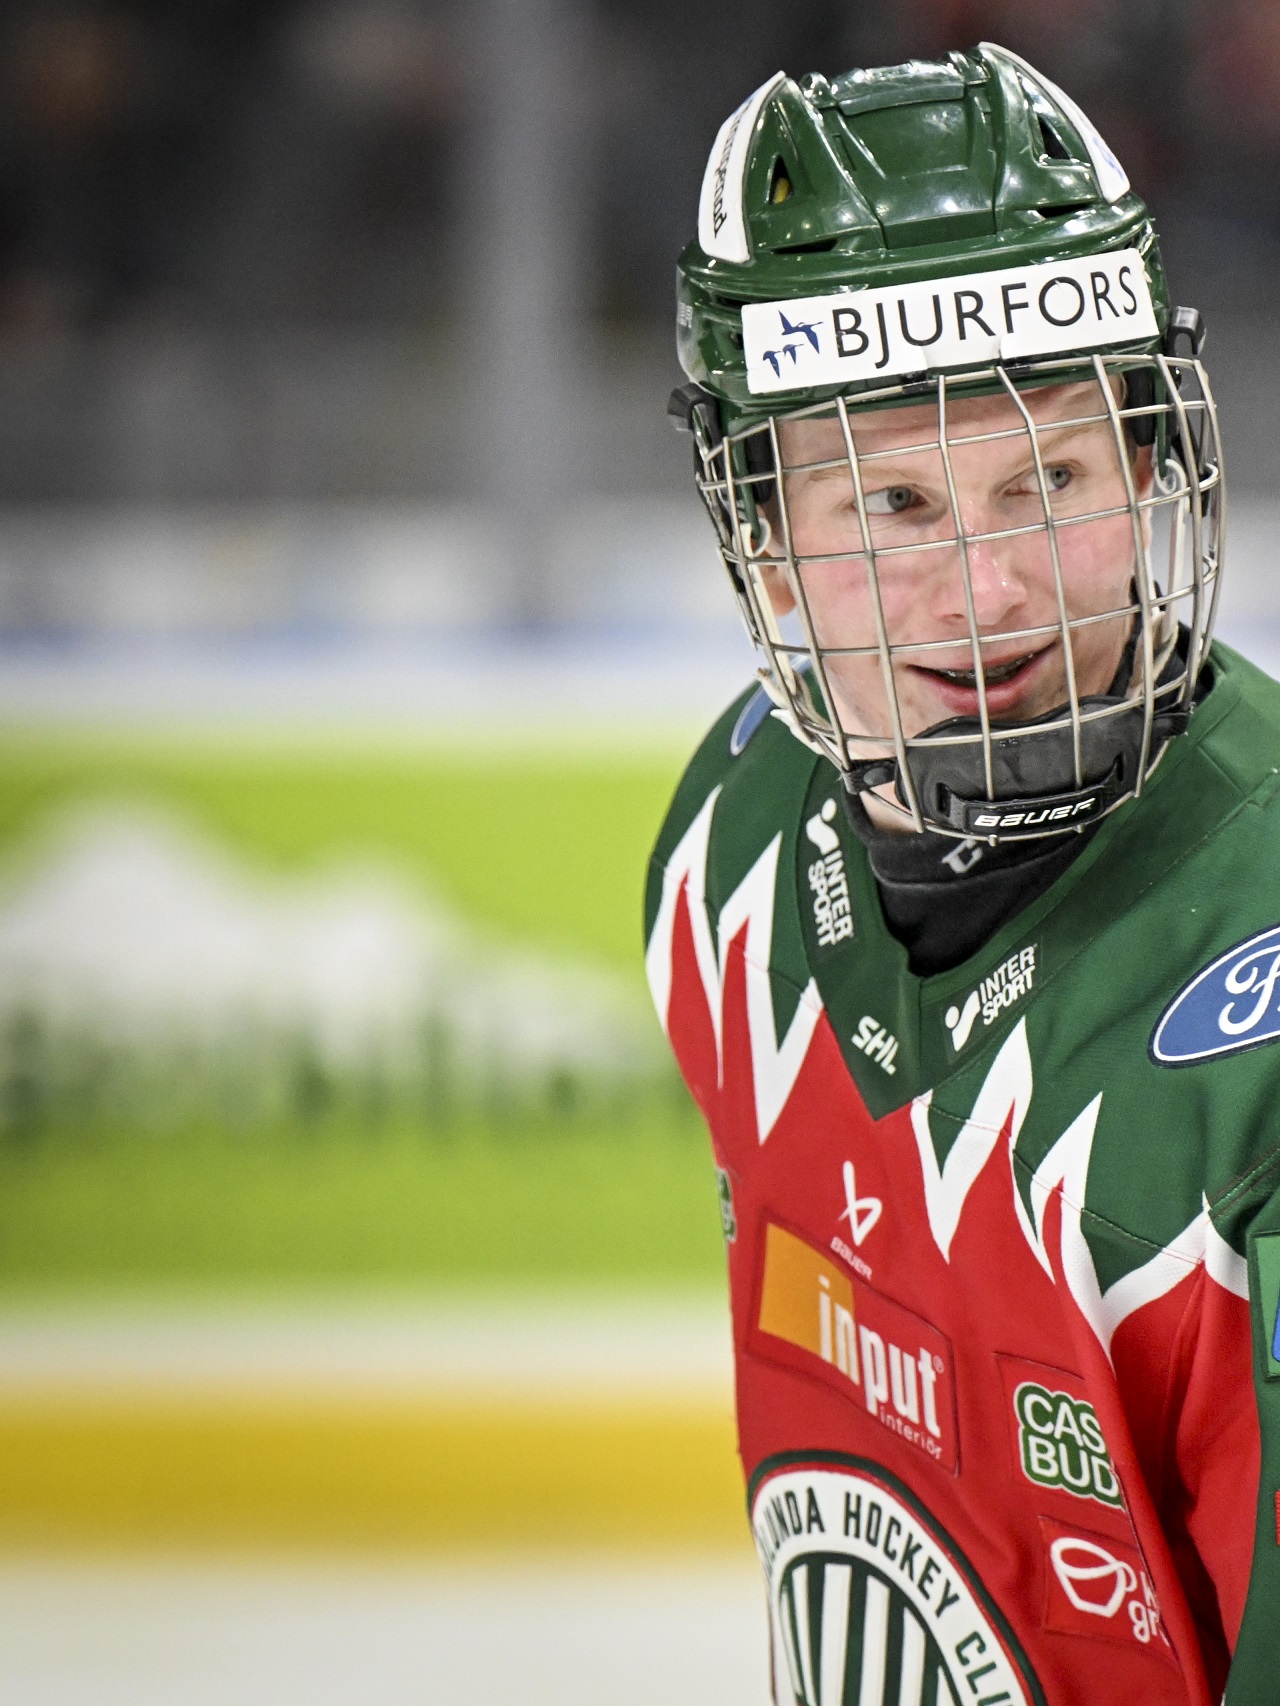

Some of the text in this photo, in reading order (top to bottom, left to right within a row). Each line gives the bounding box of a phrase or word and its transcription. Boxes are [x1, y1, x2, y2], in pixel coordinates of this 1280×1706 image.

[832, 266, 1137, 369] BJURFORS
[808, 859, 837, 946] SPORT
[824, 850, 854, 941] INTER
[979, 945, 1036, 1004] INTER
[982, 965, 1036, 1025] SPORT
[818, 1274, 941, 1438] input
[843, 1491, 960, 1618] HOCKEY
